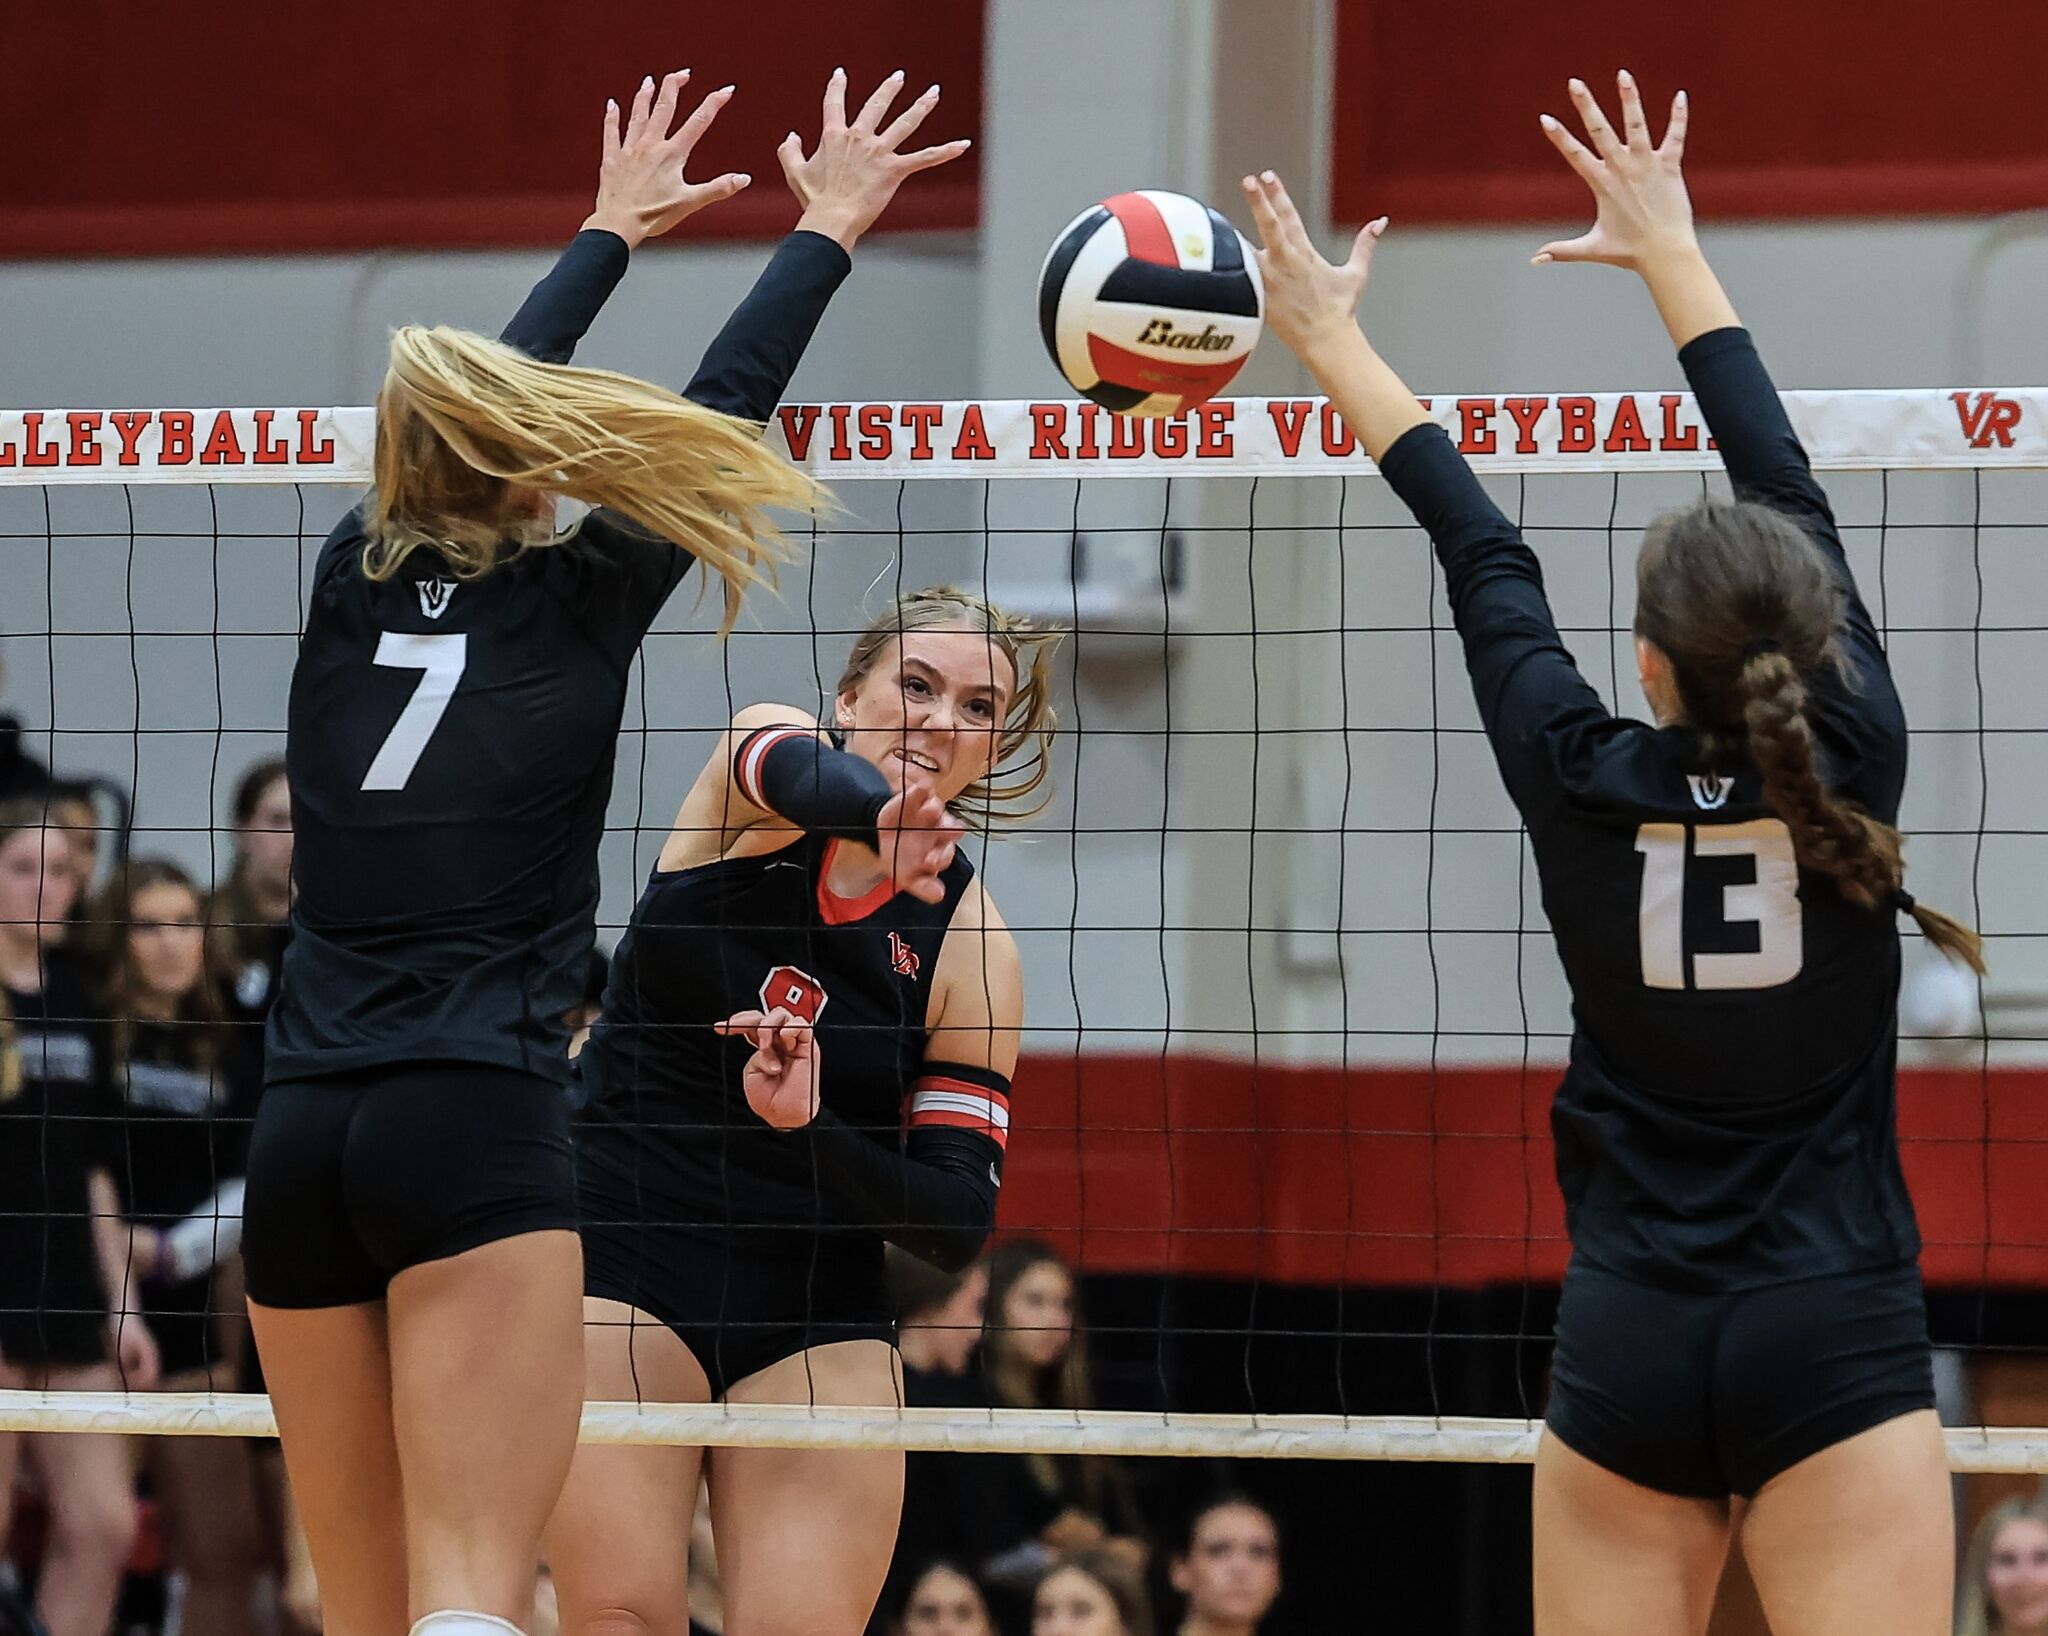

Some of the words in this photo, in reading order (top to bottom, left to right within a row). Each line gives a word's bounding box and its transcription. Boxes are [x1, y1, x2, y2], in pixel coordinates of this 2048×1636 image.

[1136, 318, 1235, 351] Baden
[777, 404, 996, 461] VISTA
[1029, 402, 1235, 460] RIDGE
[1267, 395, 1721, 458] VOEYBAL
[1948, 391, 2022, 448] VR
[360, 630, 468, 791] 7
[1634, 818, 1804, 990] 13
